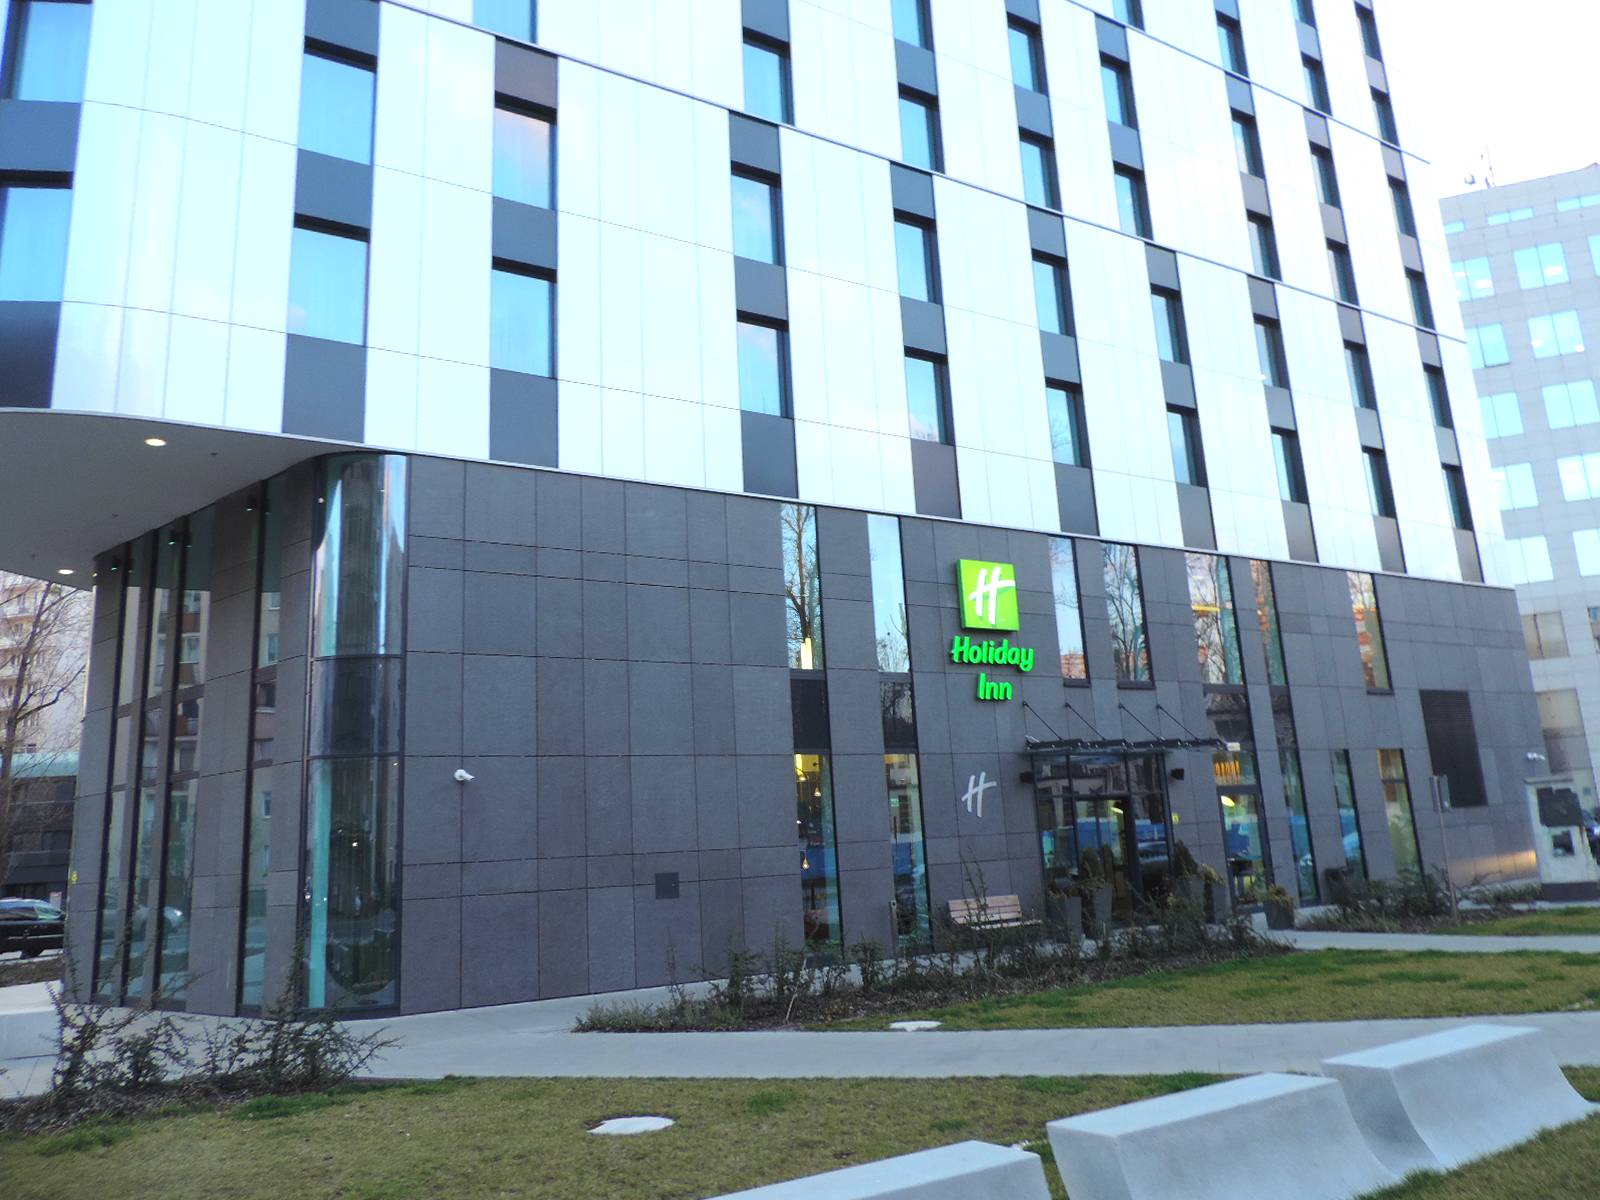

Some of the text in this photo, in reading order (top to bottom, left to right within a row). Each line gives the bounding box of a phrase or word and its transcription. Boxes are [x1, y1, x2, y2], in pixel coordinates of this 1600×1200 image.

[968, 566, 1016, 624] H
[951, 635, 1034, 672] Holiday
[976, 672, 1013, 701] Inn
[961, 771, 997, 818] H
